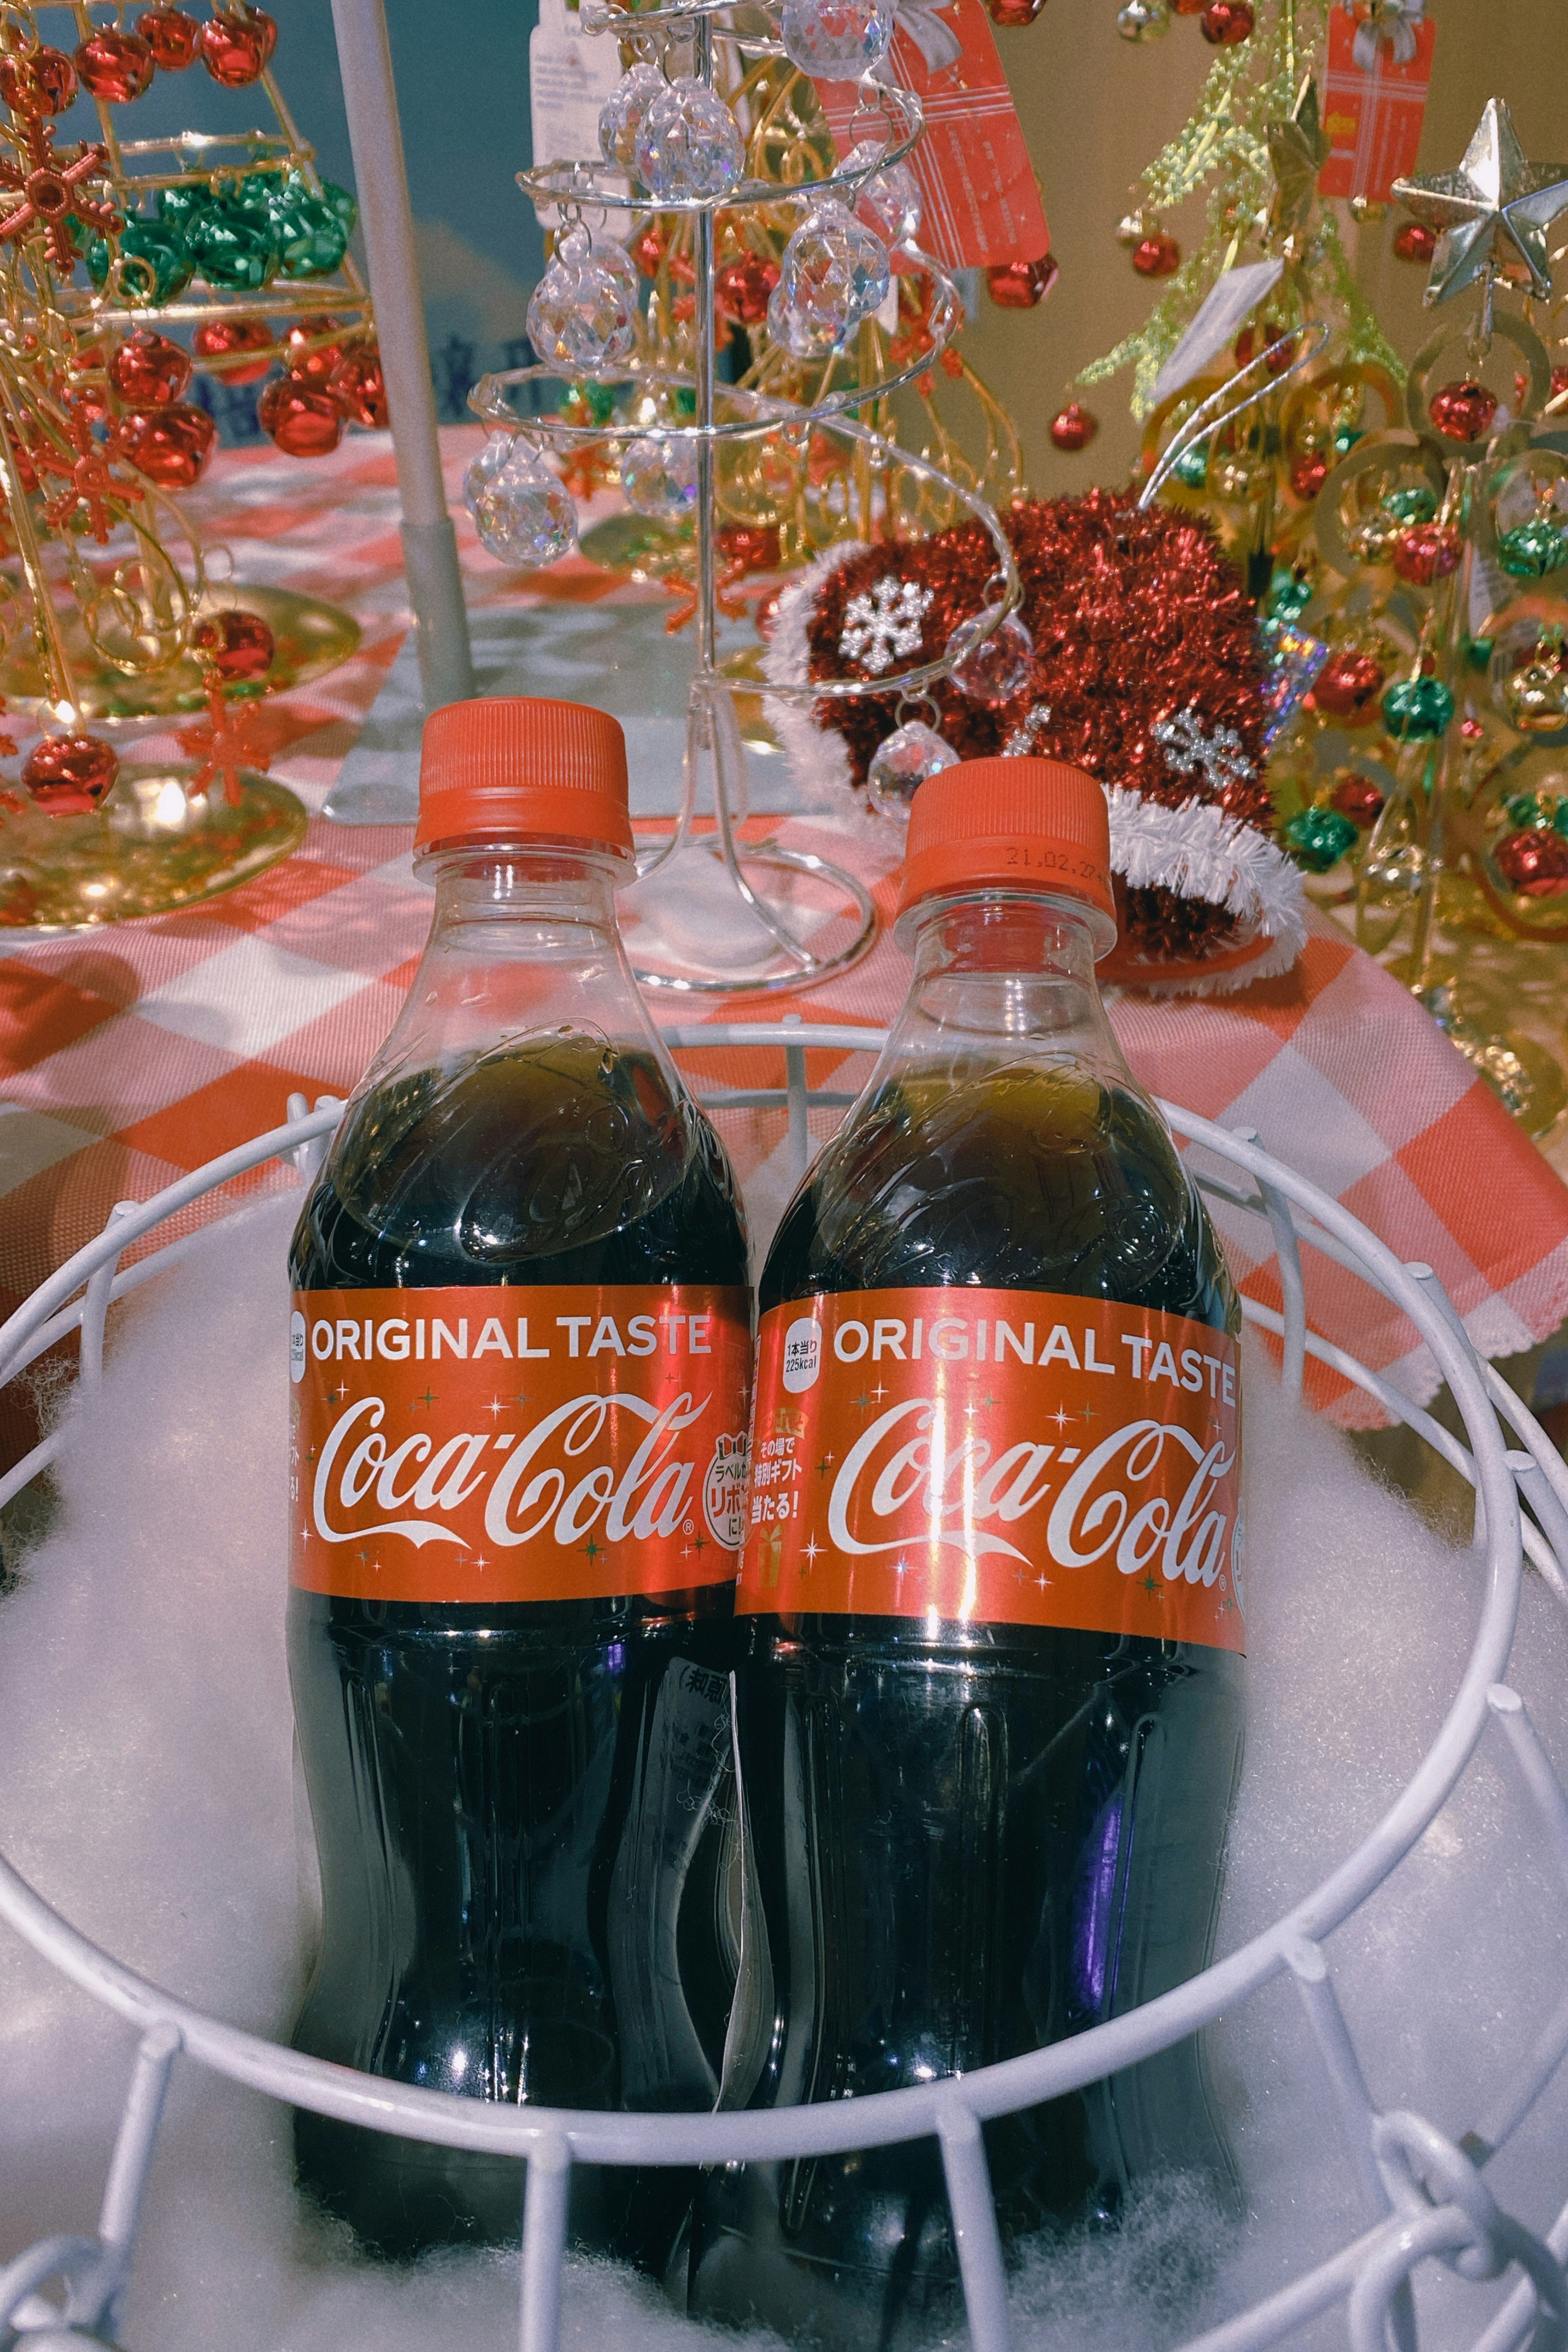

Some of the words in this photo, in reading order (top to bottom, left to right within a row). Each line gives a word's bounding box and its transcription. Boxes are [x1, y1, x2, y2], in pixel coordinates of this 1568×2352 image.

[312, 1317, 550, 1360] ORIGINAL
[556, 1315, 712, 1357] TASTE
[788, 1339, 817, 1356] 1本当り
[786, 1354, 817, 1373] 225kcal
[834, 1317, 1115, 1375] ORIGINAL
[1120, 1333, 1237, 1409] TASTE
[761, 1436, 795, 1458] その場で
[313, 1391, 713, 1550] Coca-Cola
[754, 1458, 802, 1488] 特別ギフト
[711, 1483, 747, 1518] リボ
[751, 1490, 799, 1524] 当たる!
[828, 1397, 1237, 1587] Coca-Cola
